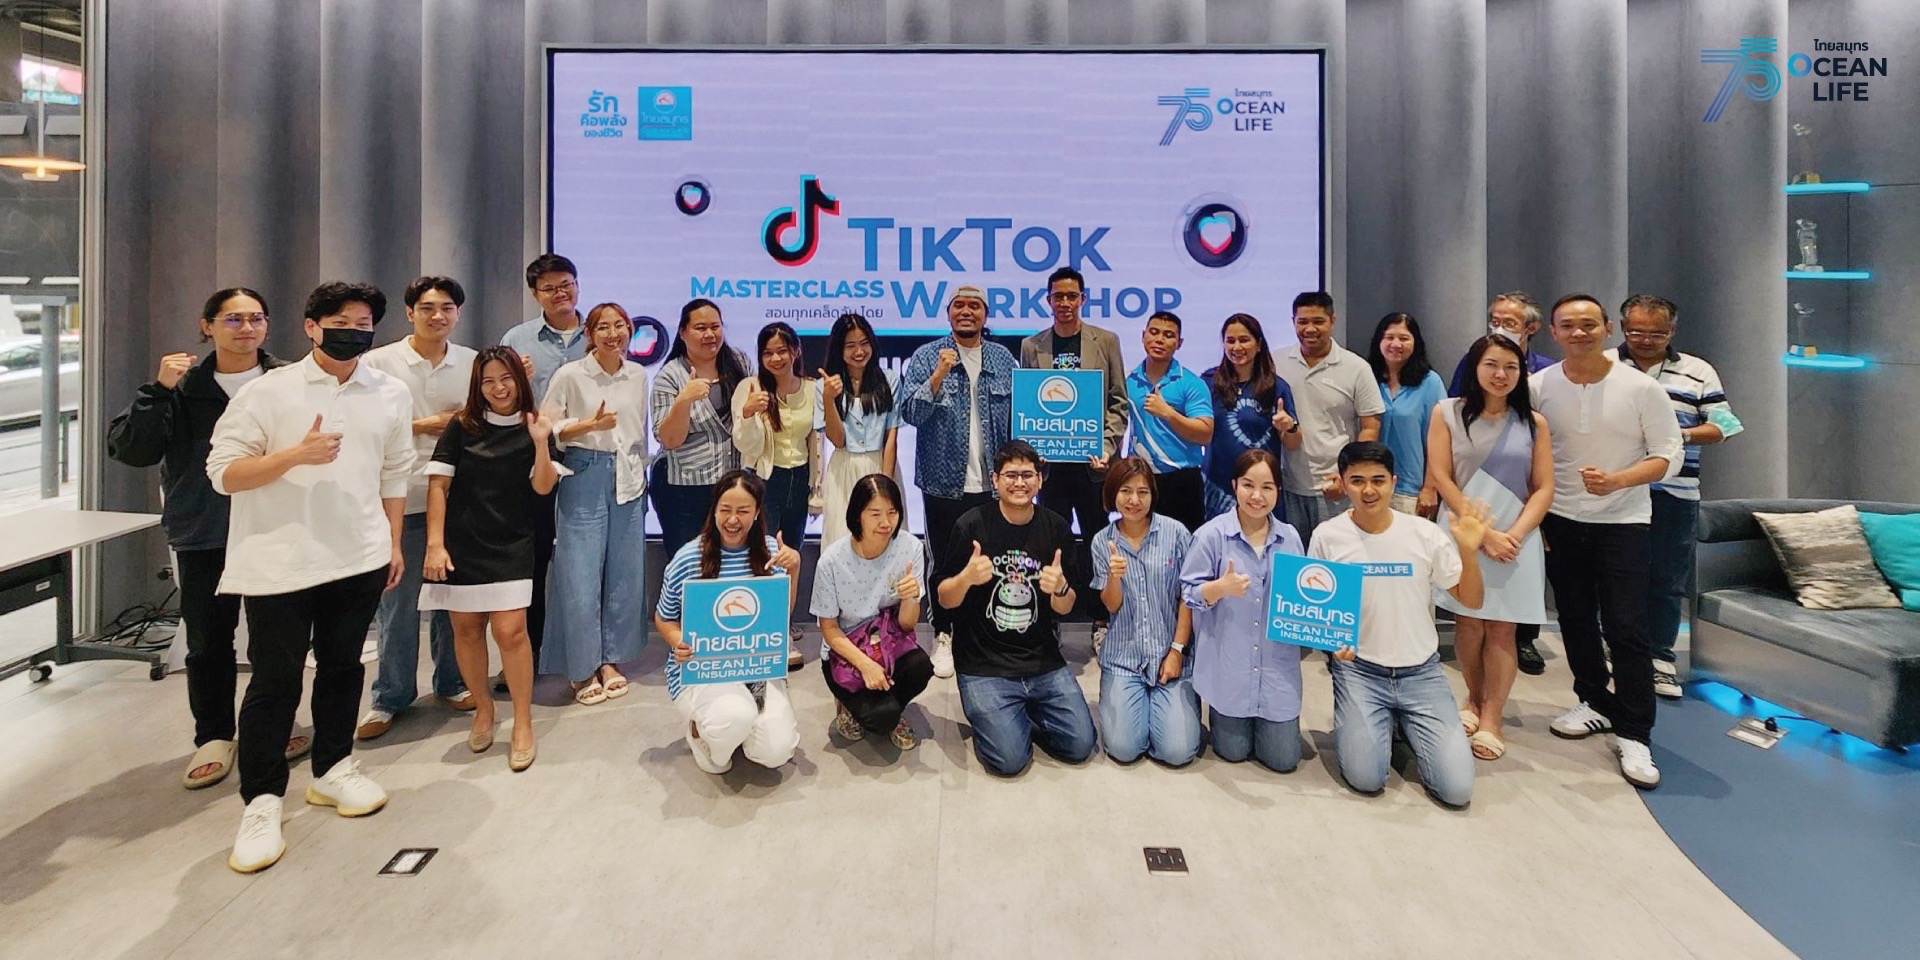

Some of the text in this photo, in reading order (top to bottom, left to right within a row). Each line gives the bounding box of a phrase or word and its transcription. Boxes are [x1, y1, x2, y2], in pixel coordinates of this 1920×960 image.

[587, 90, 618, 113] รัก
[1216, 98, 1285, 115] OCEAN
[1234, 118, 1273, 131] LIFE
[690, 276, 885, 299] MASTERCLASS
[890, 280, 1182, 319] WRKHOP
[1017, 412, 1098, 436] ไทยสมุทร
[1069, 437, 1098, 449] LIFE
[1037, 449, 1089, 457] SURANCE
[1362, 565, 1409, 575] CEAN LIFE
[1275, 593, 1355, 627] ไทยสมุทร
[1272, 619, 1354, 642] OCEAN LIFE
[1280, 629, 1344, 648] INSURANCE
[688, 631, 783, 654] ไทยสมุทร
[686, 655, 782, 671] OCEAN LIFE
[697, 666, 771, 679] INSURANCE
